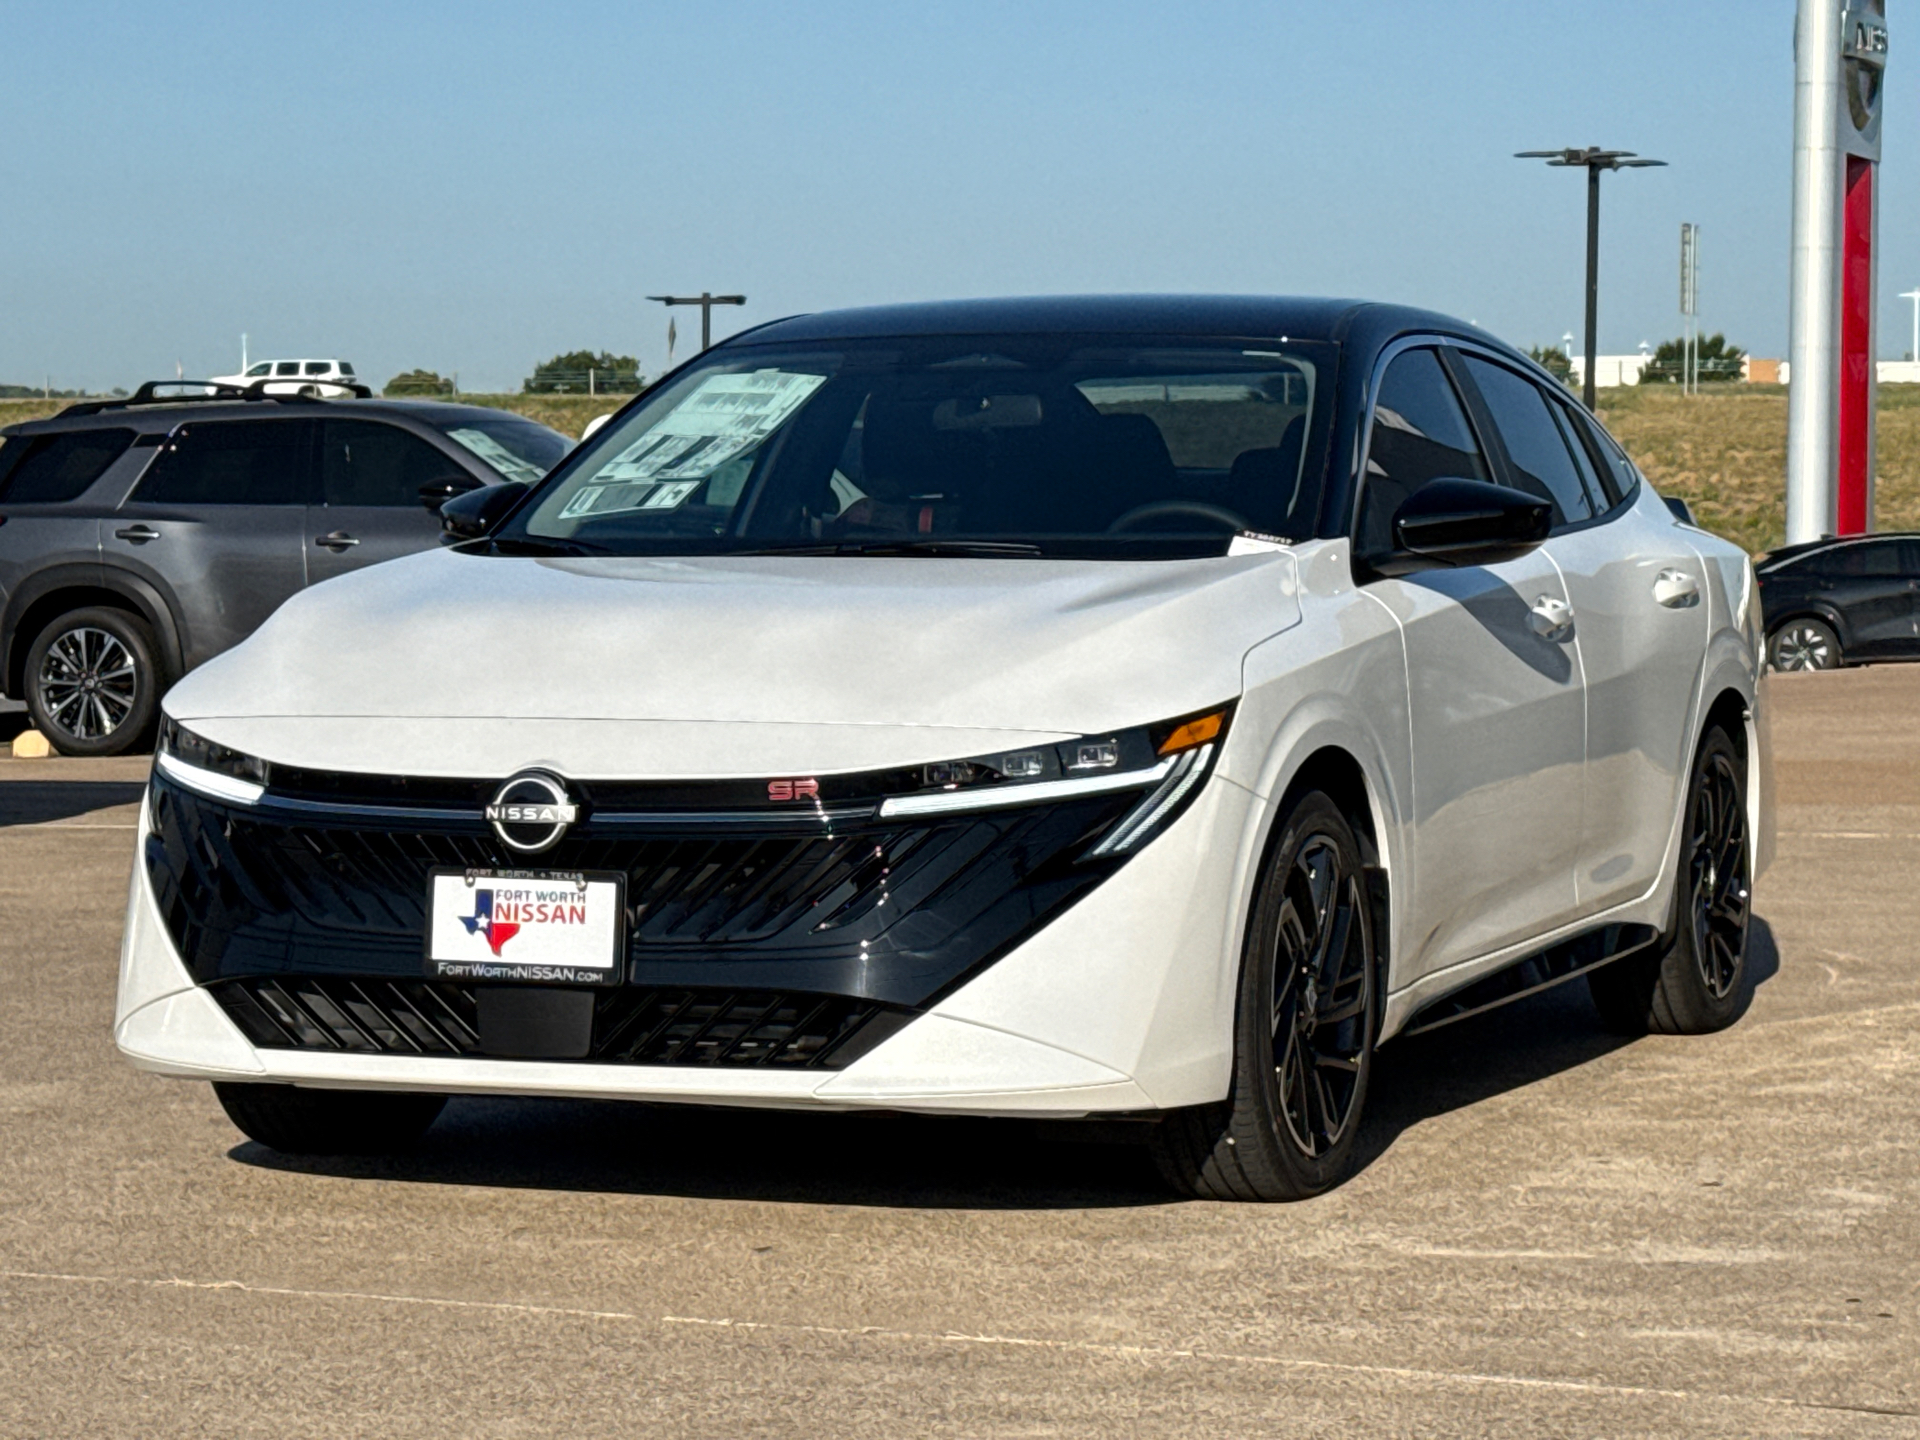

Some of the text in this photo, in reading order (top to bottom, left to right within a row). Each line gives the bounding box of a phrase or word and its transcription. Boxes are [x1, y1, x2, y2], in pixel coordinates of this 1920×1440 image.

[767, 779, 819, 801] SR
[486, 804, 575, 822] NISSAN
[465, 868, 584, 881] FORT WORTH TEXAS
[495, 889, 586, 904] FORT WORTH
[494, 903, 586, 924] NISSAN
